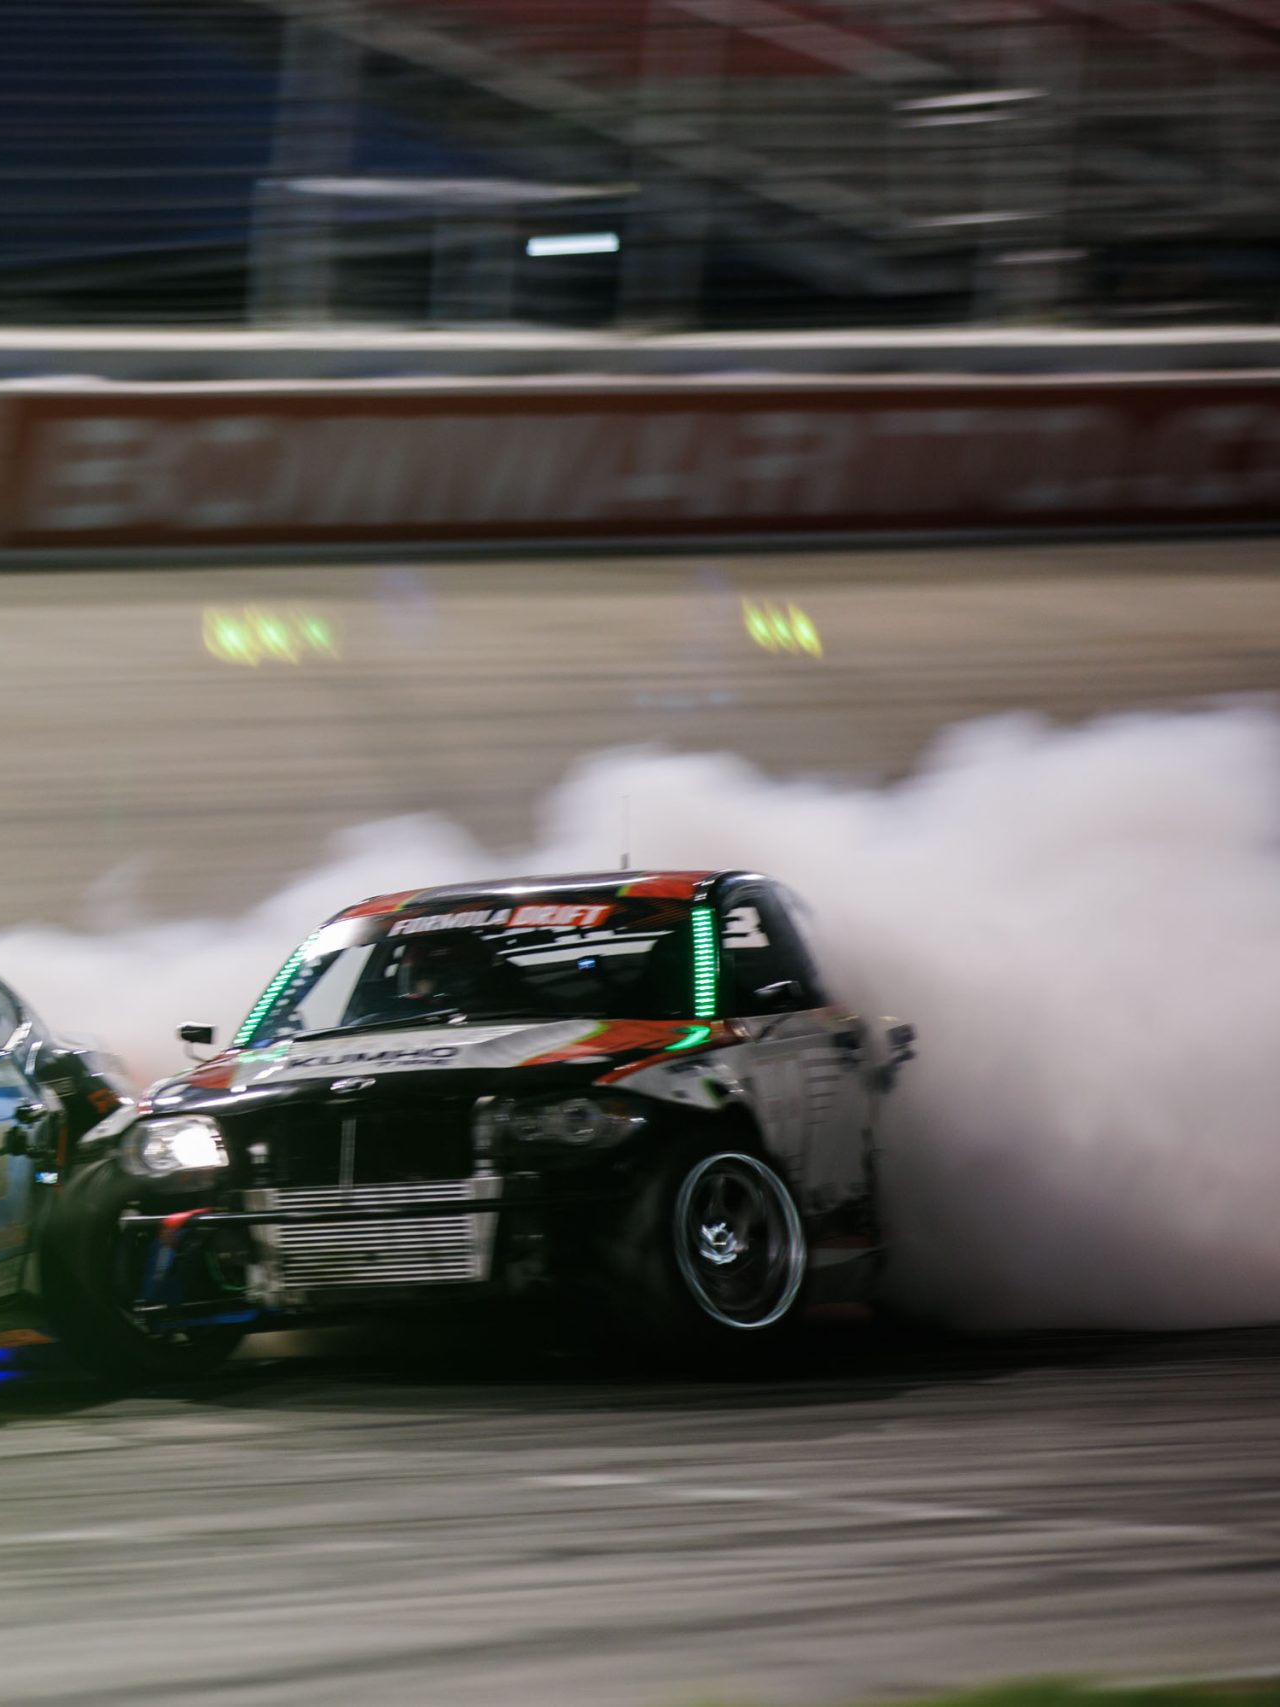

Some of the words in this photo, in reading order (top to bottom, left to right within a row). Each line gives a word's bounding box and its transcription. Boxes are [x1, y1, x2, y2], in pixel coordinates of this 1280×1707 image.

[387, 909, 513, 936] FORMULA
[509, 904, 610, 927] DRIFT
[288, 1046, 459, 1069] KUMHO
